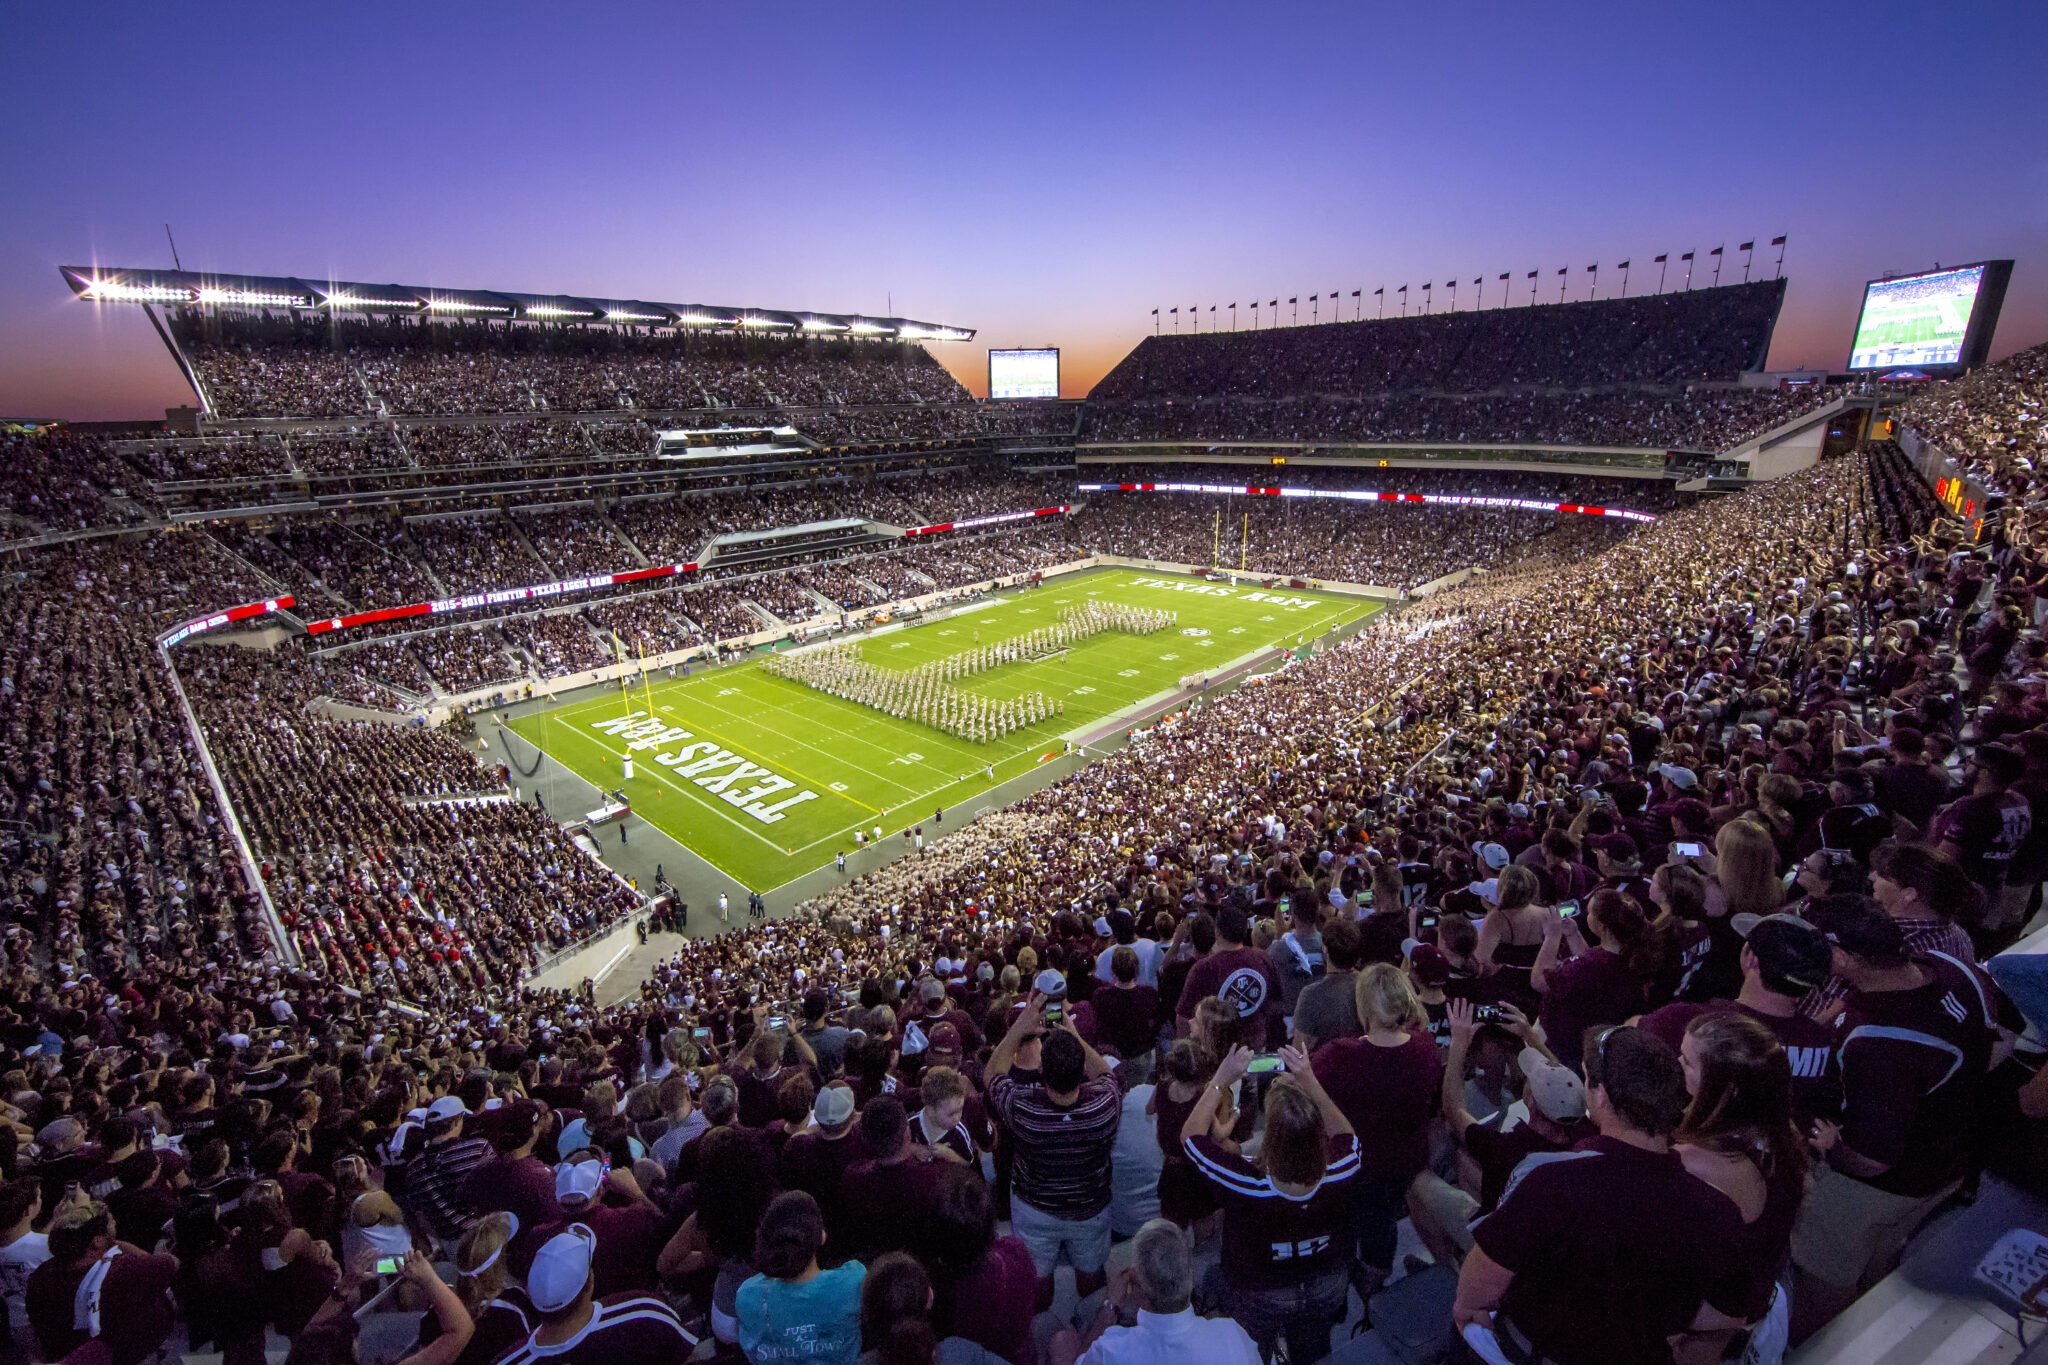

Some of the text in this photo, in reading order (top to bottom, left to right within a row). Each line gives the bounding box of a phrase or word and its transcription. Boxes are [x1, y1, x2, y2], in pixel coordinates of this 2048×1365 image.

[531, 583, 561, 597] TEXAS
[1129, 577, 1321, 609] TEXAS A&M
[590, 710, 820, 825] TEXAS A&M
[1780, 1044, 1831, 1078] MIT
[783, 1323, 815, 1336] JUST
